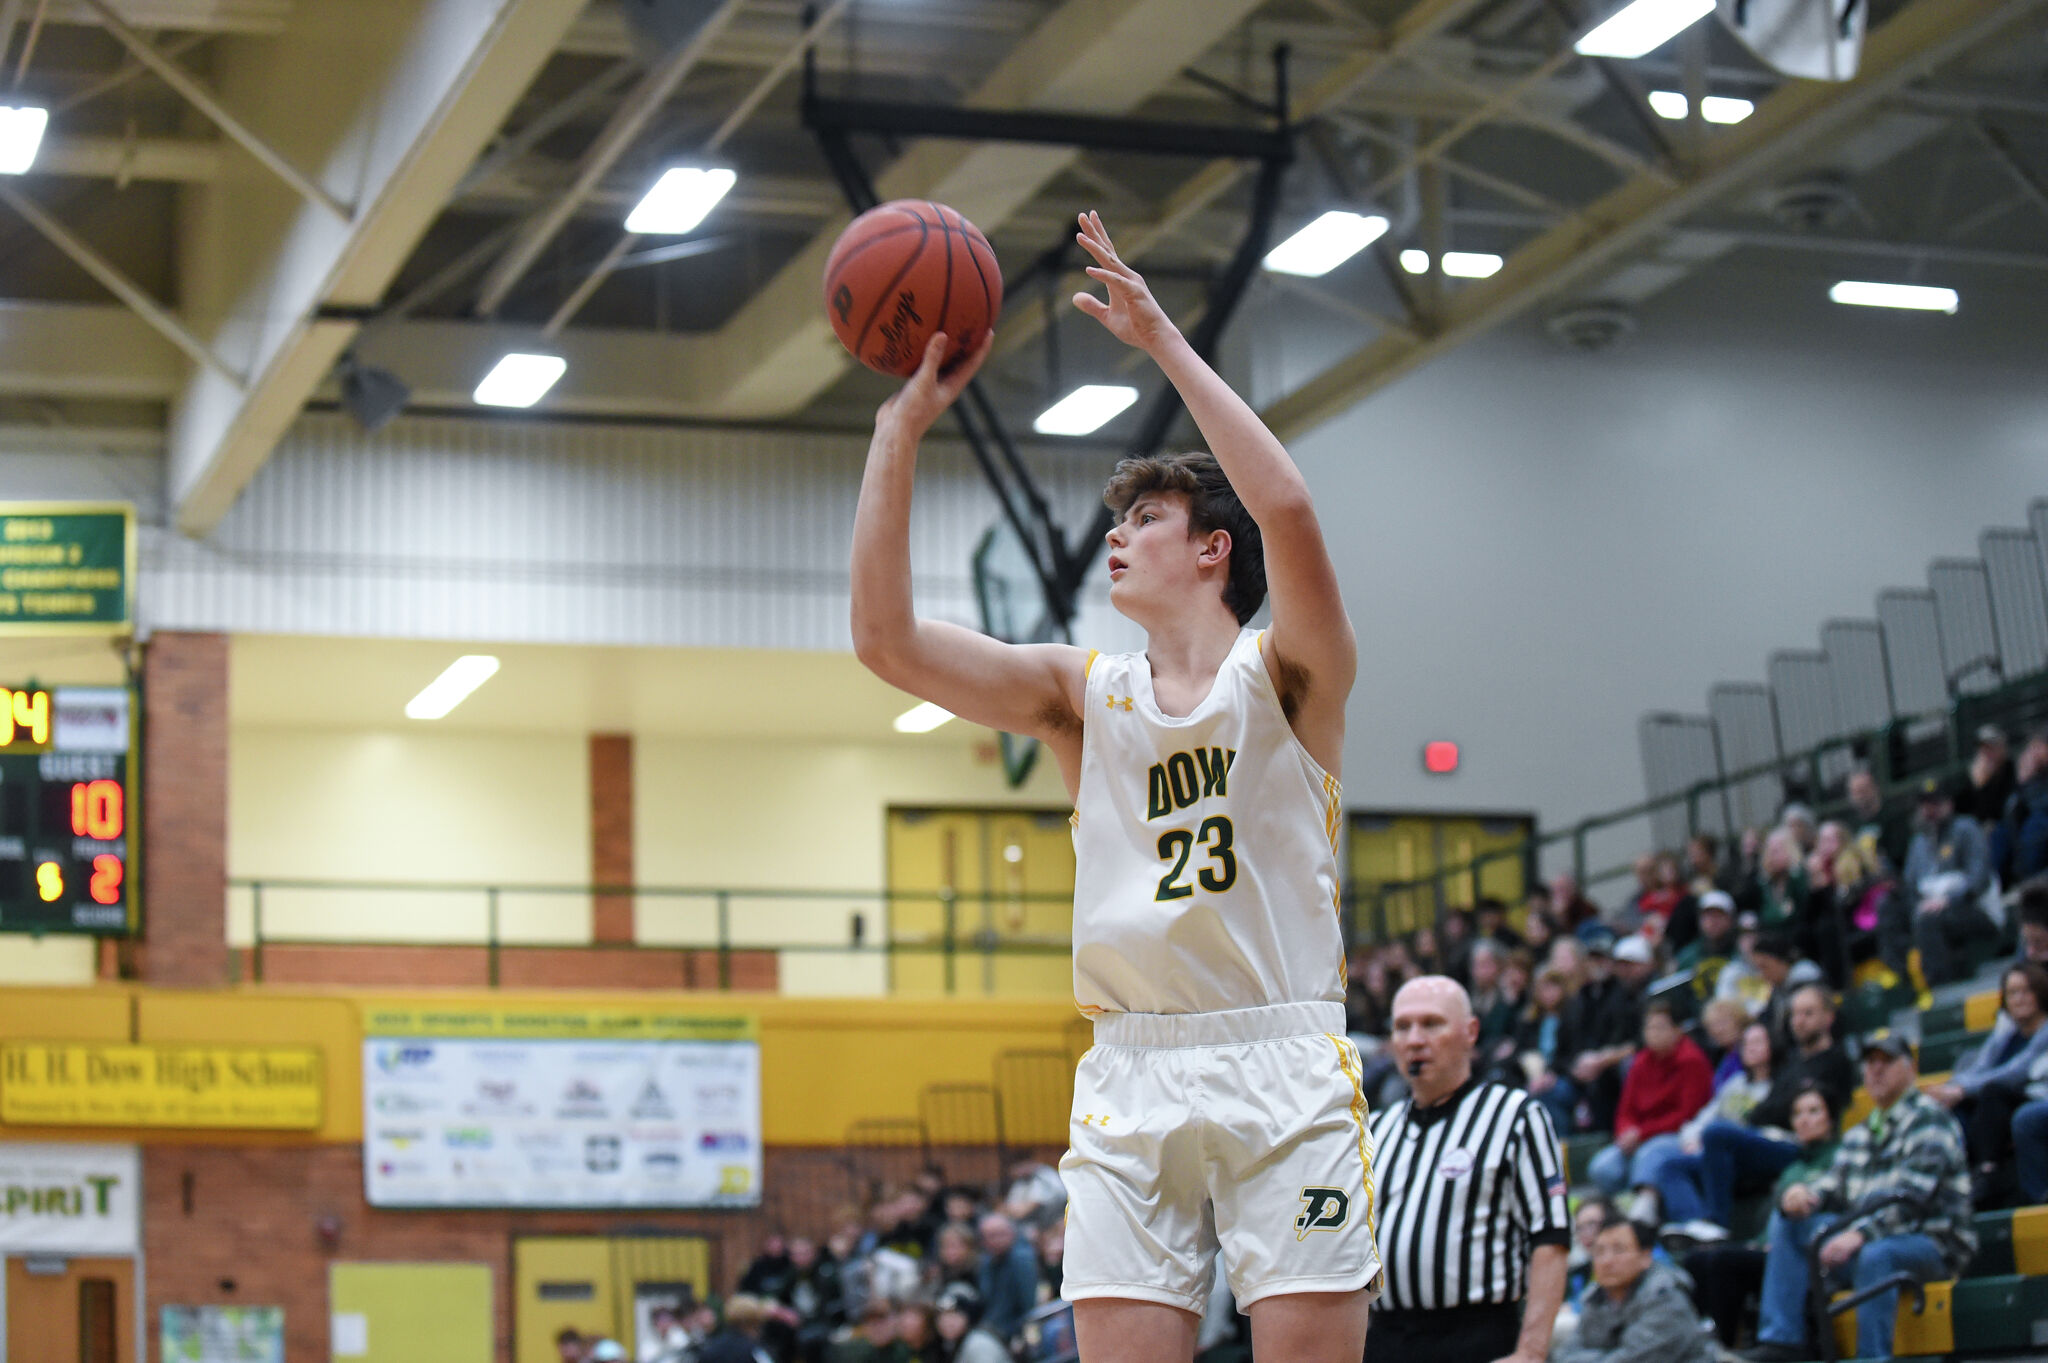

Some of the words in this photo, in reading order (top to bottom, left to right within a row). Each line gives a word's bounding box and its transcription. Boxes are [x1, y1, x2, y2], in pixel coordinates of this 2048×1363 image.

[72, 780, 123, 840] 10
[1147, 745, 1236, 822] DOW
[90, 854, 123, 904] 2
[1153, 814, 1238, 903] 23
[87, 1053, 143, 1084] Dow
[155, 1056, 217, 1092] High
[230, 1058, 313, 1085] School
